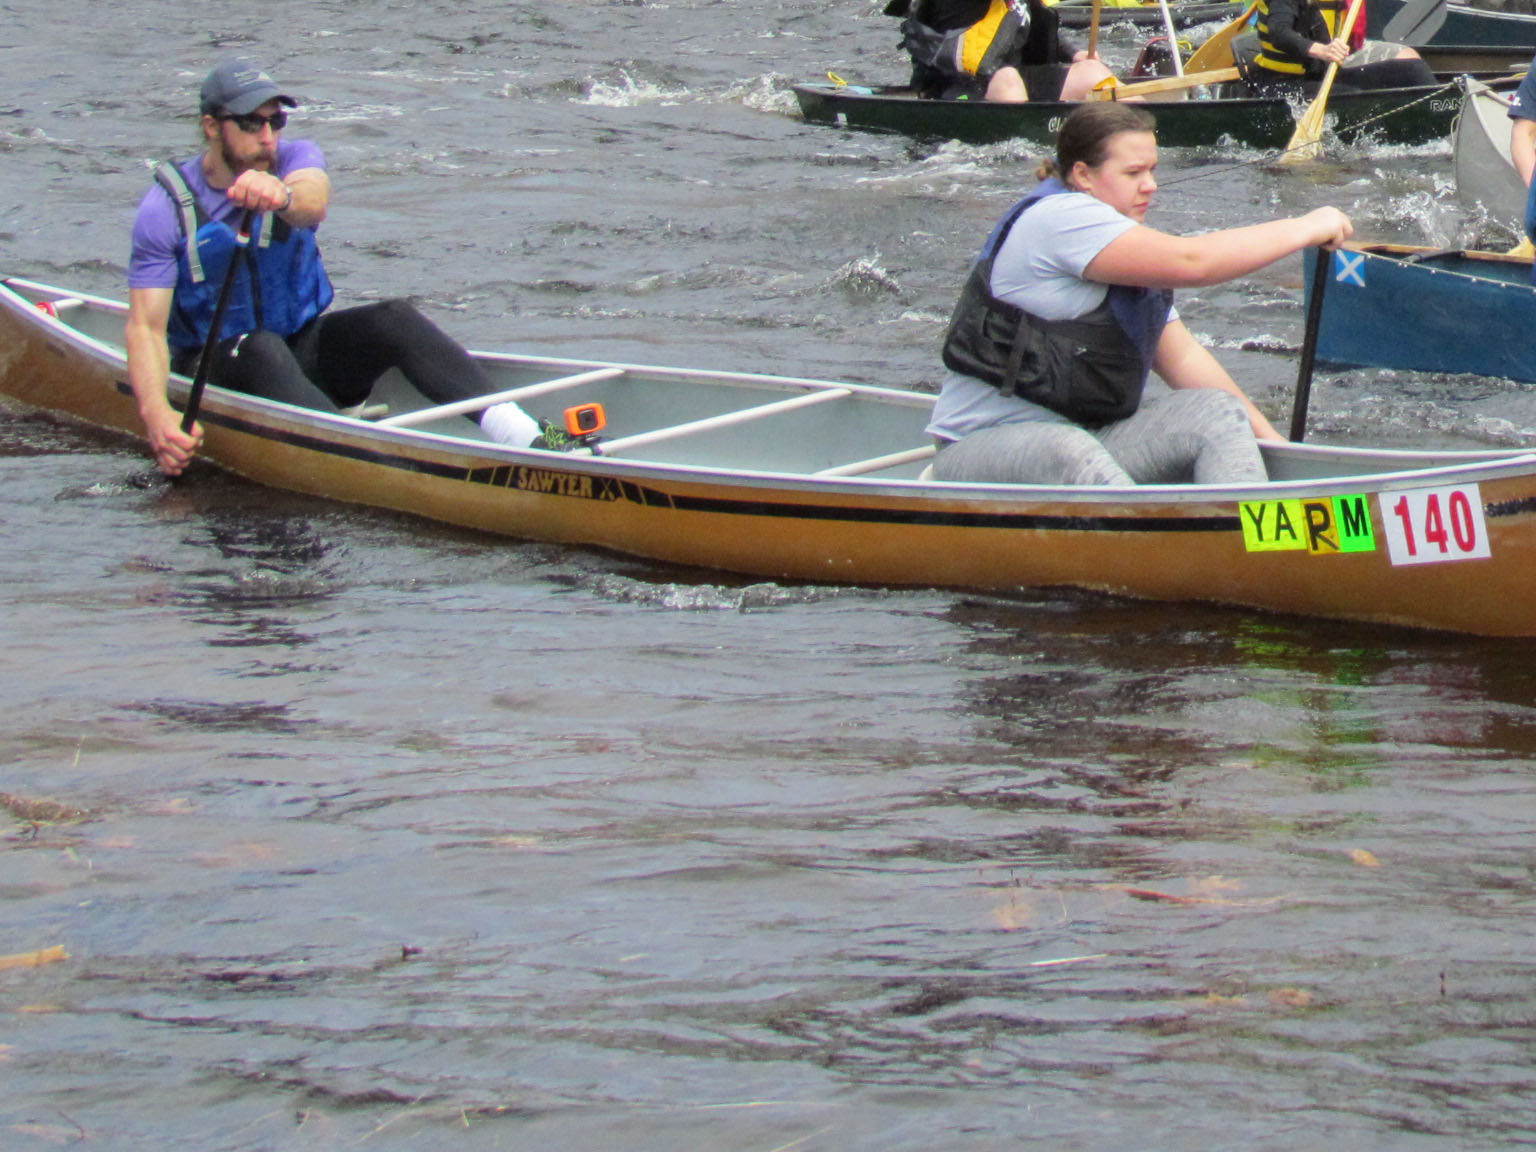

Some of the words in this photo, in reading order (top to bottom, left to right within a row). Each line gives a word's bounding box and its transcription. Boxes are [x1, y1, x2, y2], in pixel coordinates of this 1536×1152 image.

[1430, 98, 1463, 112] RAN
[517, 465, 593, 499] SAWYER
[1394, 490, 1476, 557] 140
